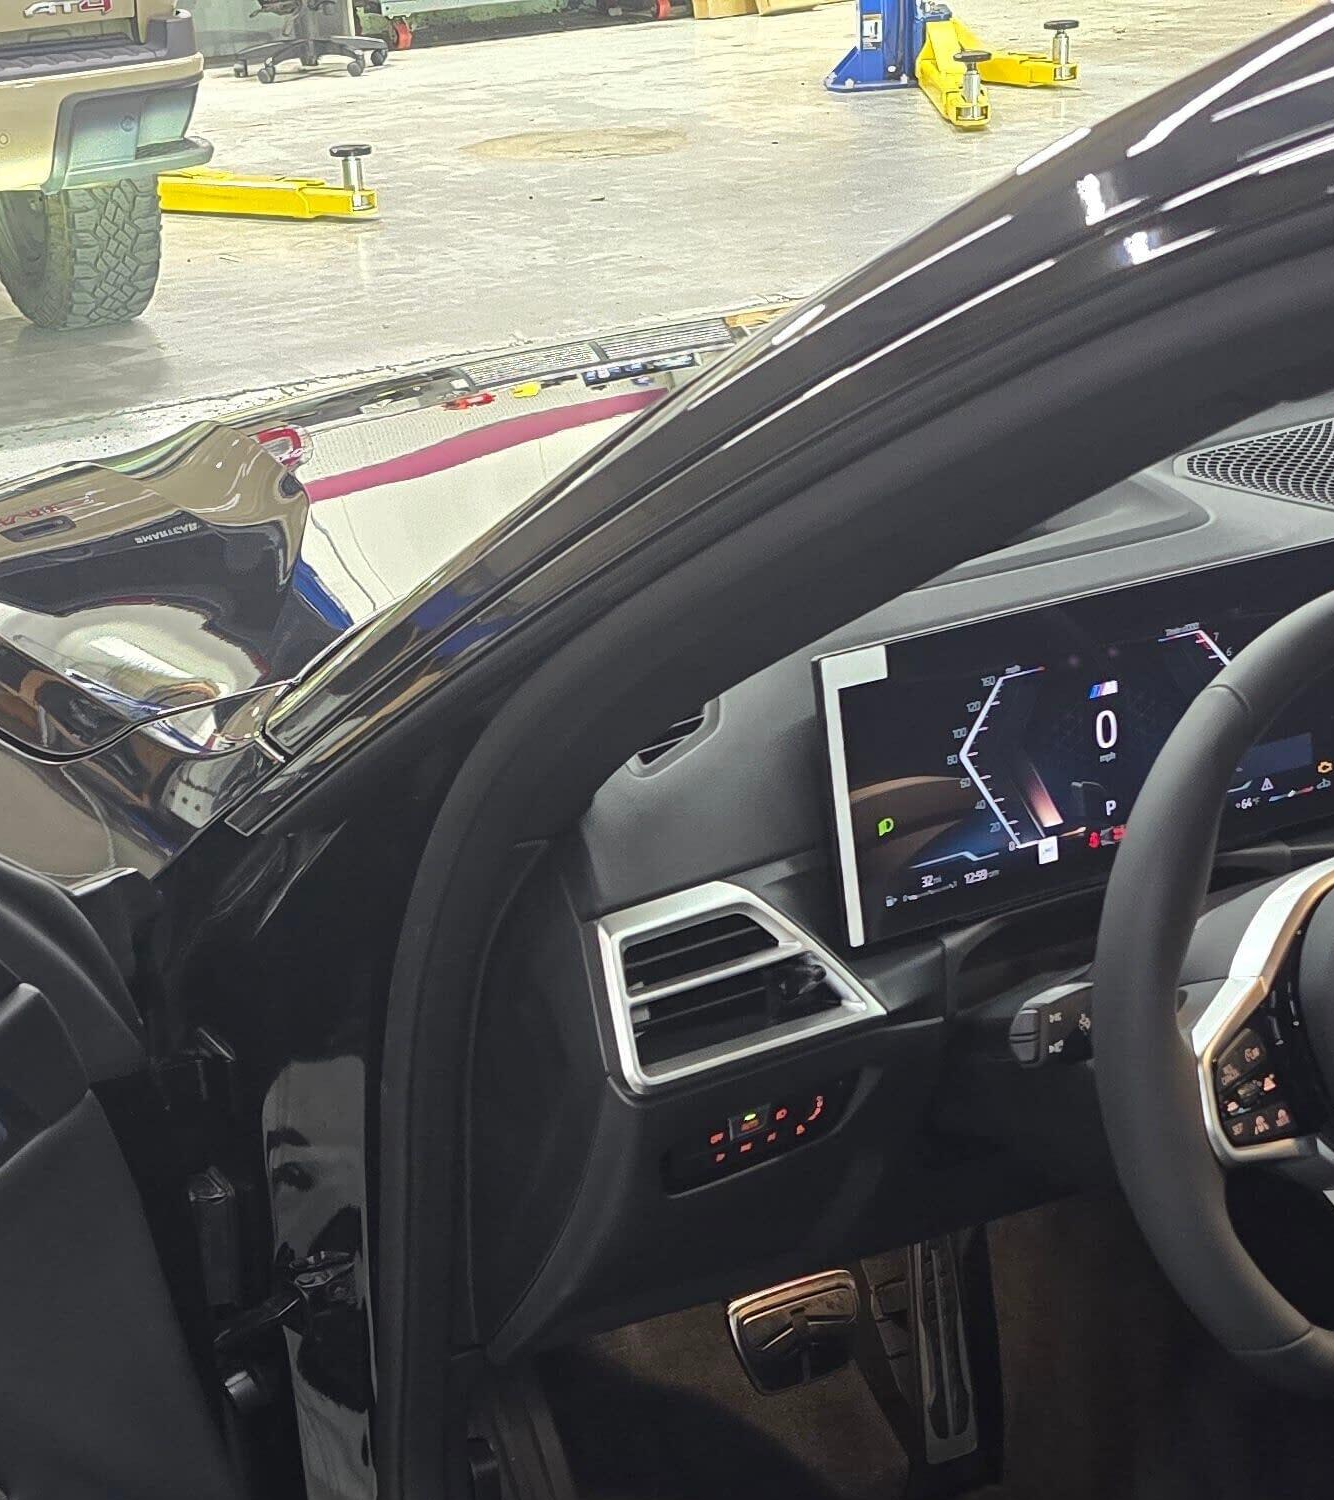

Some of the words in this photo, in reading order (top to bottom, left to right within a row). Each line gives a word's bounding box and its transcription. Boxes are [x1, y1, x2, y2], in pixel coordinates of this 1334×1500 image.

[966, 700, 982, 712] 120
[952, 727, 968, 739] 100
[1095, 709, 1118, 749] 0
[946, 754, 959, 766] 80
[1099, 751, 1117, 763] mph
[960, 777, 972, 789] 60
[975, 799, 987, 810] 40
[1105, 799, 1118, 816] P
[989, 821, 1002, 833] 20
[1009, 840, 1016, 852] 0
